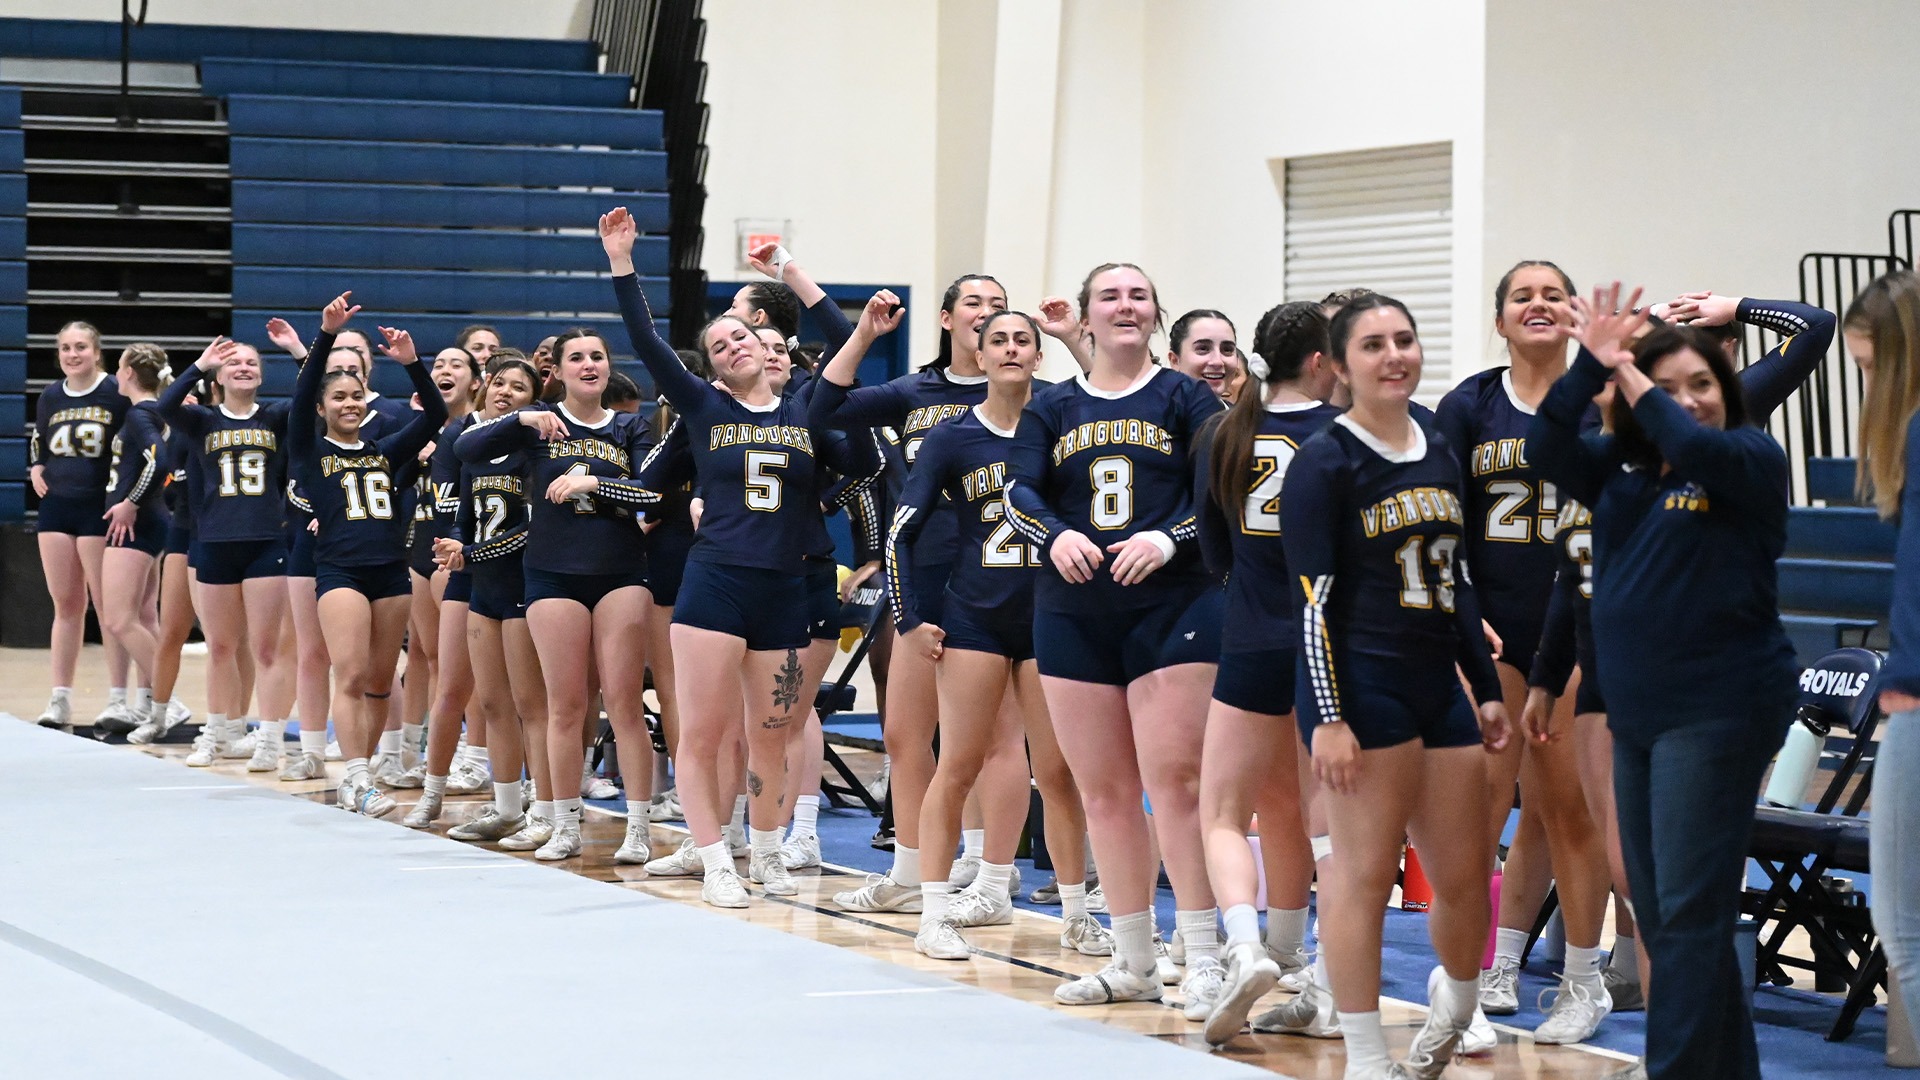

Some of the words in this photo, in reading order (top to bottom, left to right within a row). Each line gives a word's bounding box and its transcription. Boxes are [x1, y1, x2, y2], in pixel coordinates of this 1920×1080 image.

[49, 423, 105, 458] 43
[218, 449, 267, 497] 19
[340, 471, 393, 521] 16
[745, 450, 789, 512] 5
[1089, 455, 1133, 530] 8
[1799, 668, 1869, 697] ROYALS
